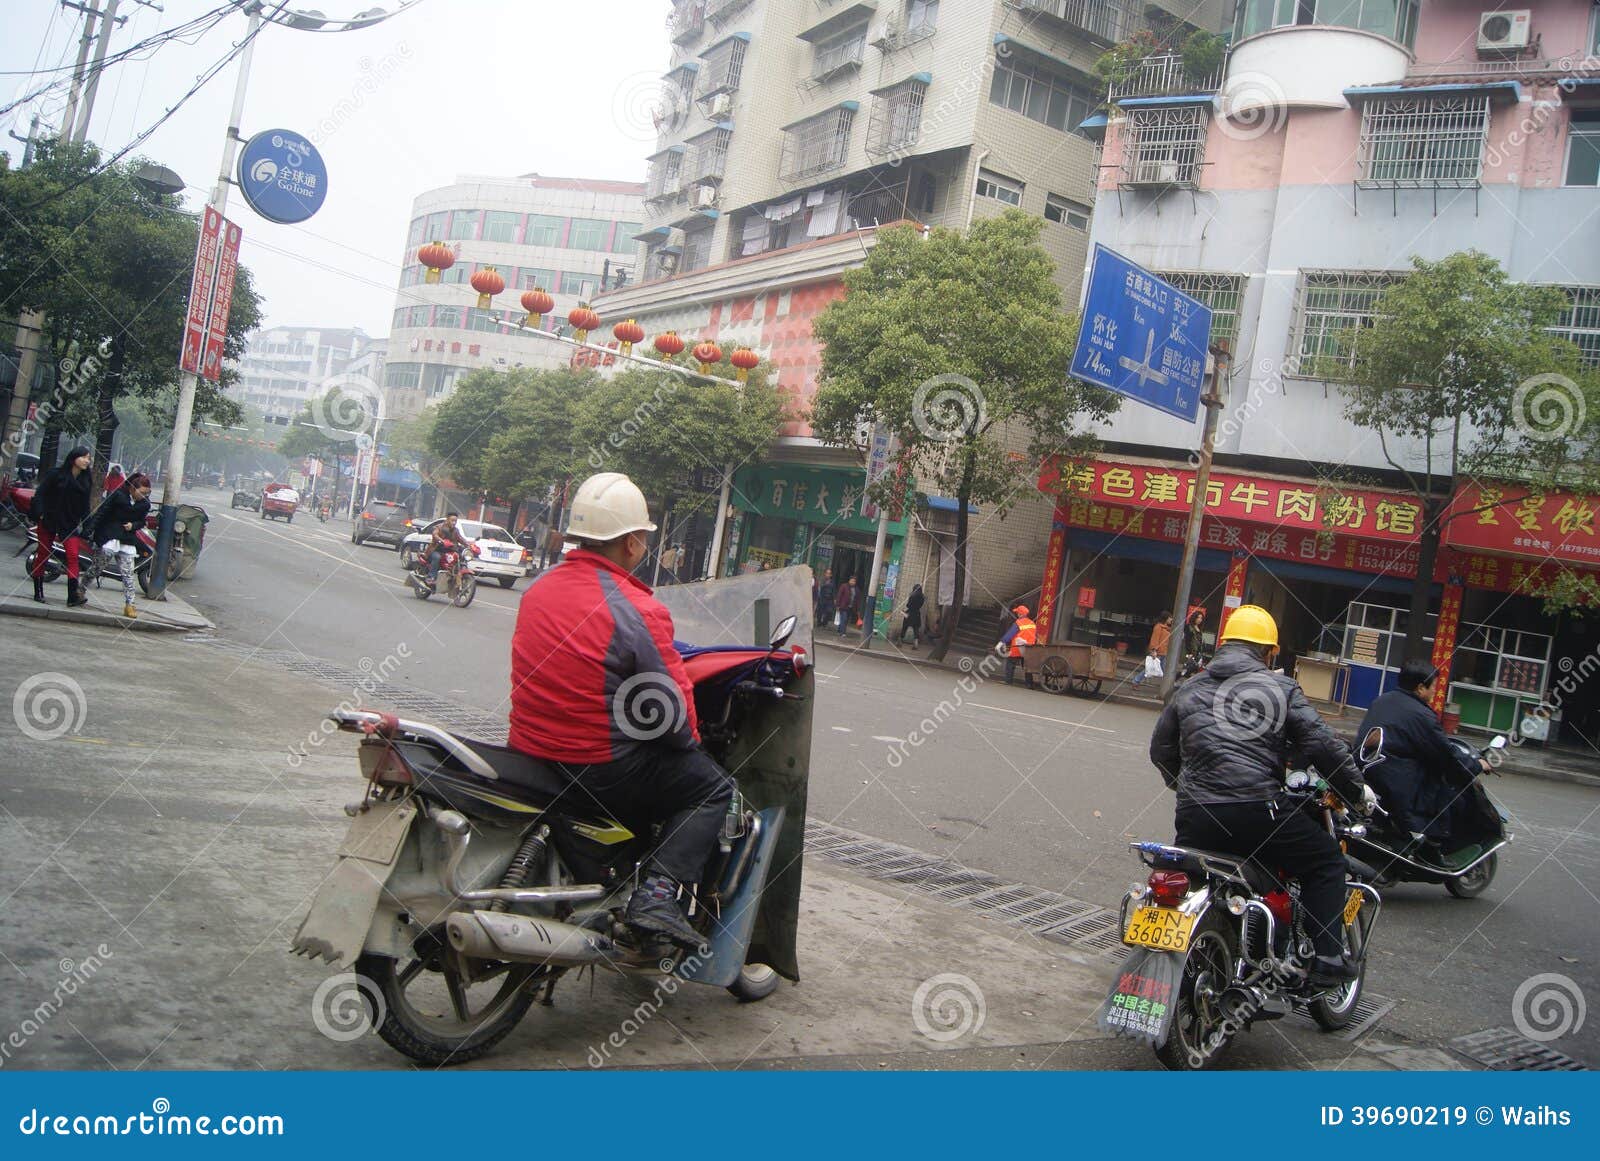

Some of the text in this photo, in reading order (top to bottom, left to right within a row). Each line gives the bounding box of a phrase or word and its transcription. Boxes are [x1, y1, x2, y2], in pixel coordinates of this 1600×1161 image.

[278, 179, 314, 197] GoTone
[279, 166, 317, 188] 全球通
[1174, 297, 1190, 318] 安江
[1094, 313, 1118, 340] 怀化
[1162, 347, 1201, 379] 国防公路
[1061, 461, 1420, 535] 特色津市牛肉粉馆
[1113, 993, 1167, 1017] 中国名牌
